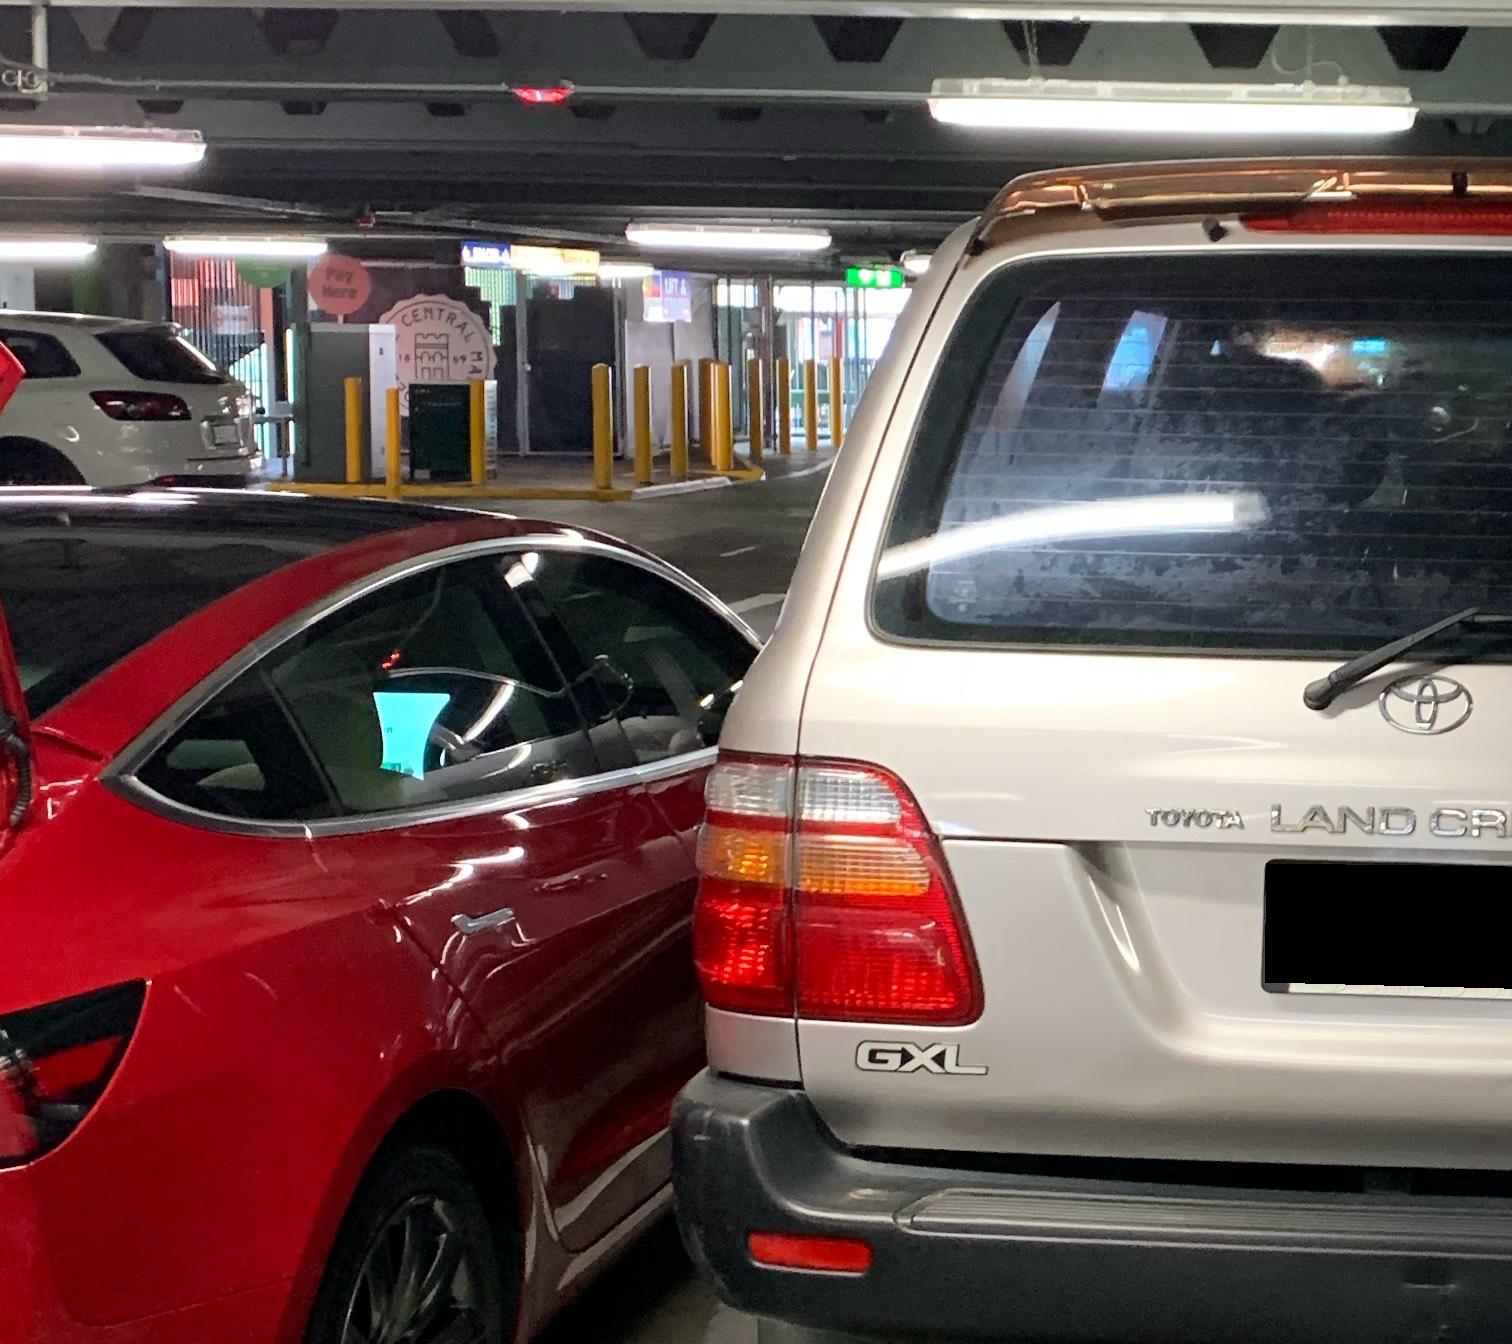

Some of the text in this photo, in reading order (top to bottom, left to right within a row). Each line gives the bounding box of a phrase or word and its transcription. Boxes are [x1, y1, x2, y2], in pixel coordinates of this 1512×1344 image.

[325, 266, 354, 284] Pay
[321, 285, 358, 300] Here
[401, 306, 476, 343] CENTRAL
[1145, 807, 1246, 831] TOYOTA
[1270, 803, 1417, 836] LAND
[855, 1039, 989, 1076] GXL
